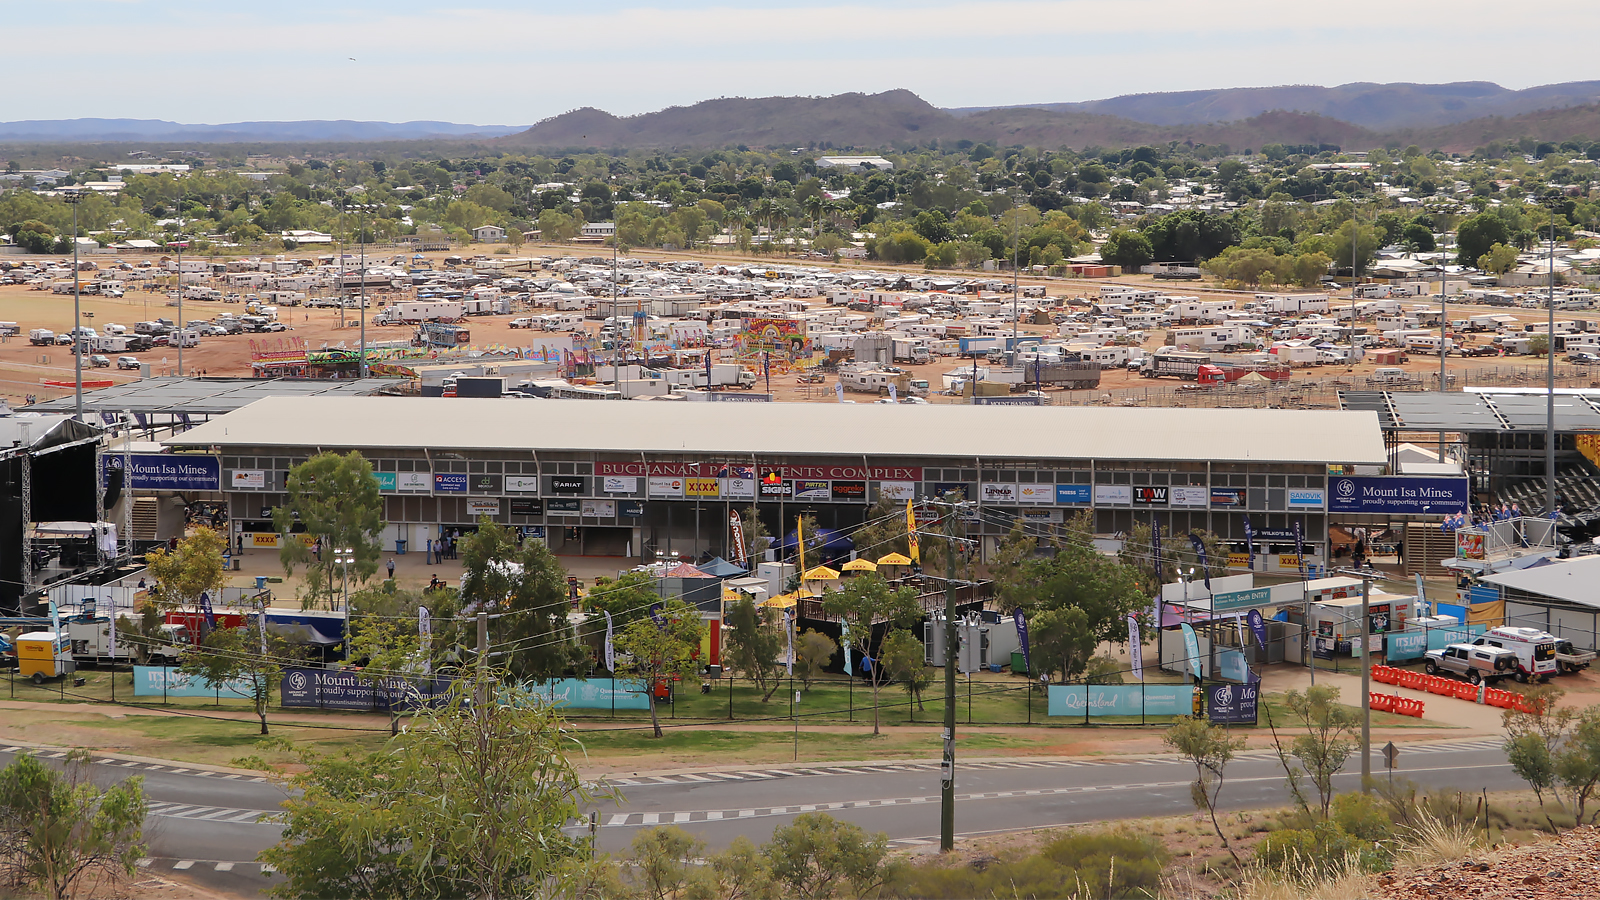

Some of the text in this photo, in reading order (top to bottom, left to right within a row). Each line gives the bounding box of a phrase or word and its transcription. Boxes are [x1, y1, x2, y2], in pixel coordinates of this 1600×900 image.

[130, 464, 207, 474] Mount Isa Mines
[602, 464, 701, 475] BUCHANAN
[760, 466, 824, 478] EVENTS
[830, 468, 914, 479] COMPLEX
[688, 483, 716, 492] XXXX
[832, 484, 864, 493] aggreko
[1362, 486, 1453, 498] Mount Isa Mines
[1136, 488, 1166, 498] TWW
[1252, 592, 1268, 600] ENTRY
[314, 673, 355, 686] Mount
[315, 687, 346, 697] poudly
[1065, 692, 1118, 709] Queensland
